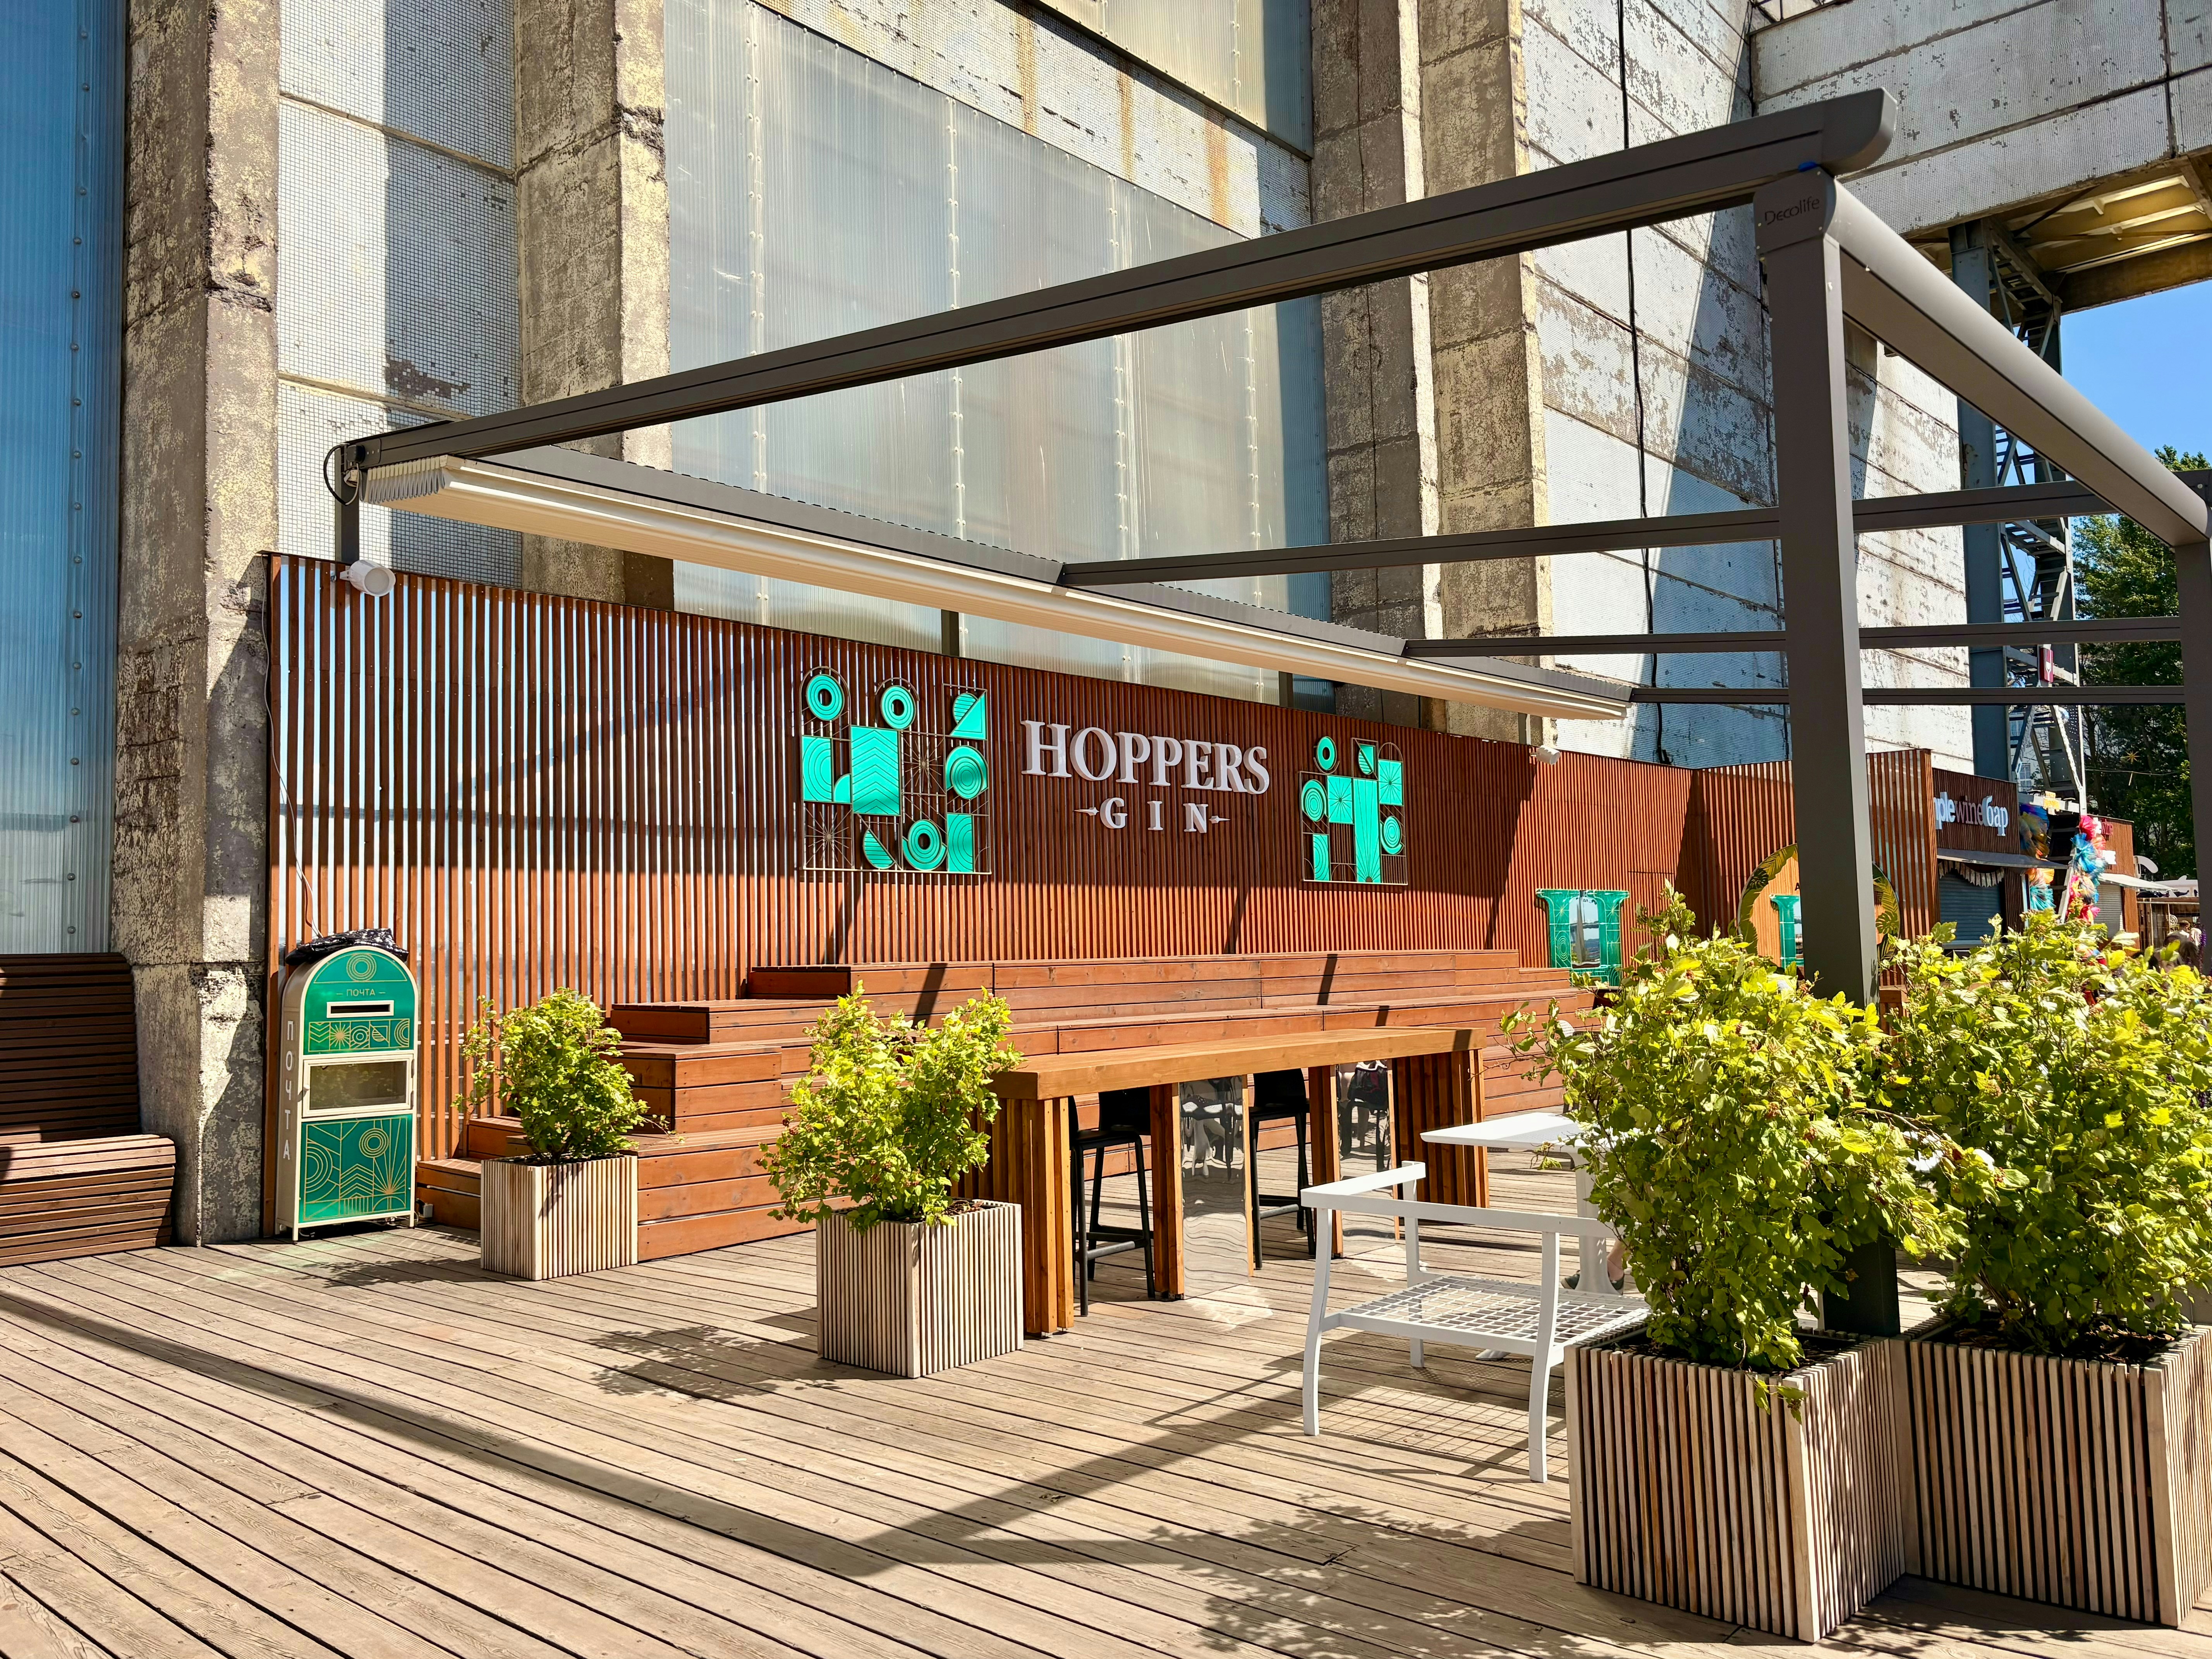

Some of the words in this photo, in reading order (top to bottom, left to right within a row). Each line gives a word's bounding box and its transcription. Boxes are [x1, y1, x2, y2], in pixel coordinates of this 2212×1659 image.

[1764, 196, 1820, 225] Decolife
[1020, 720, 1270, 795] HOPPERS
[1099, 797, 1209, 833] GIN
[347, 988, 376, 997] ПОЧТА
[283, 1020, 294, 1160] ПОЧТА
